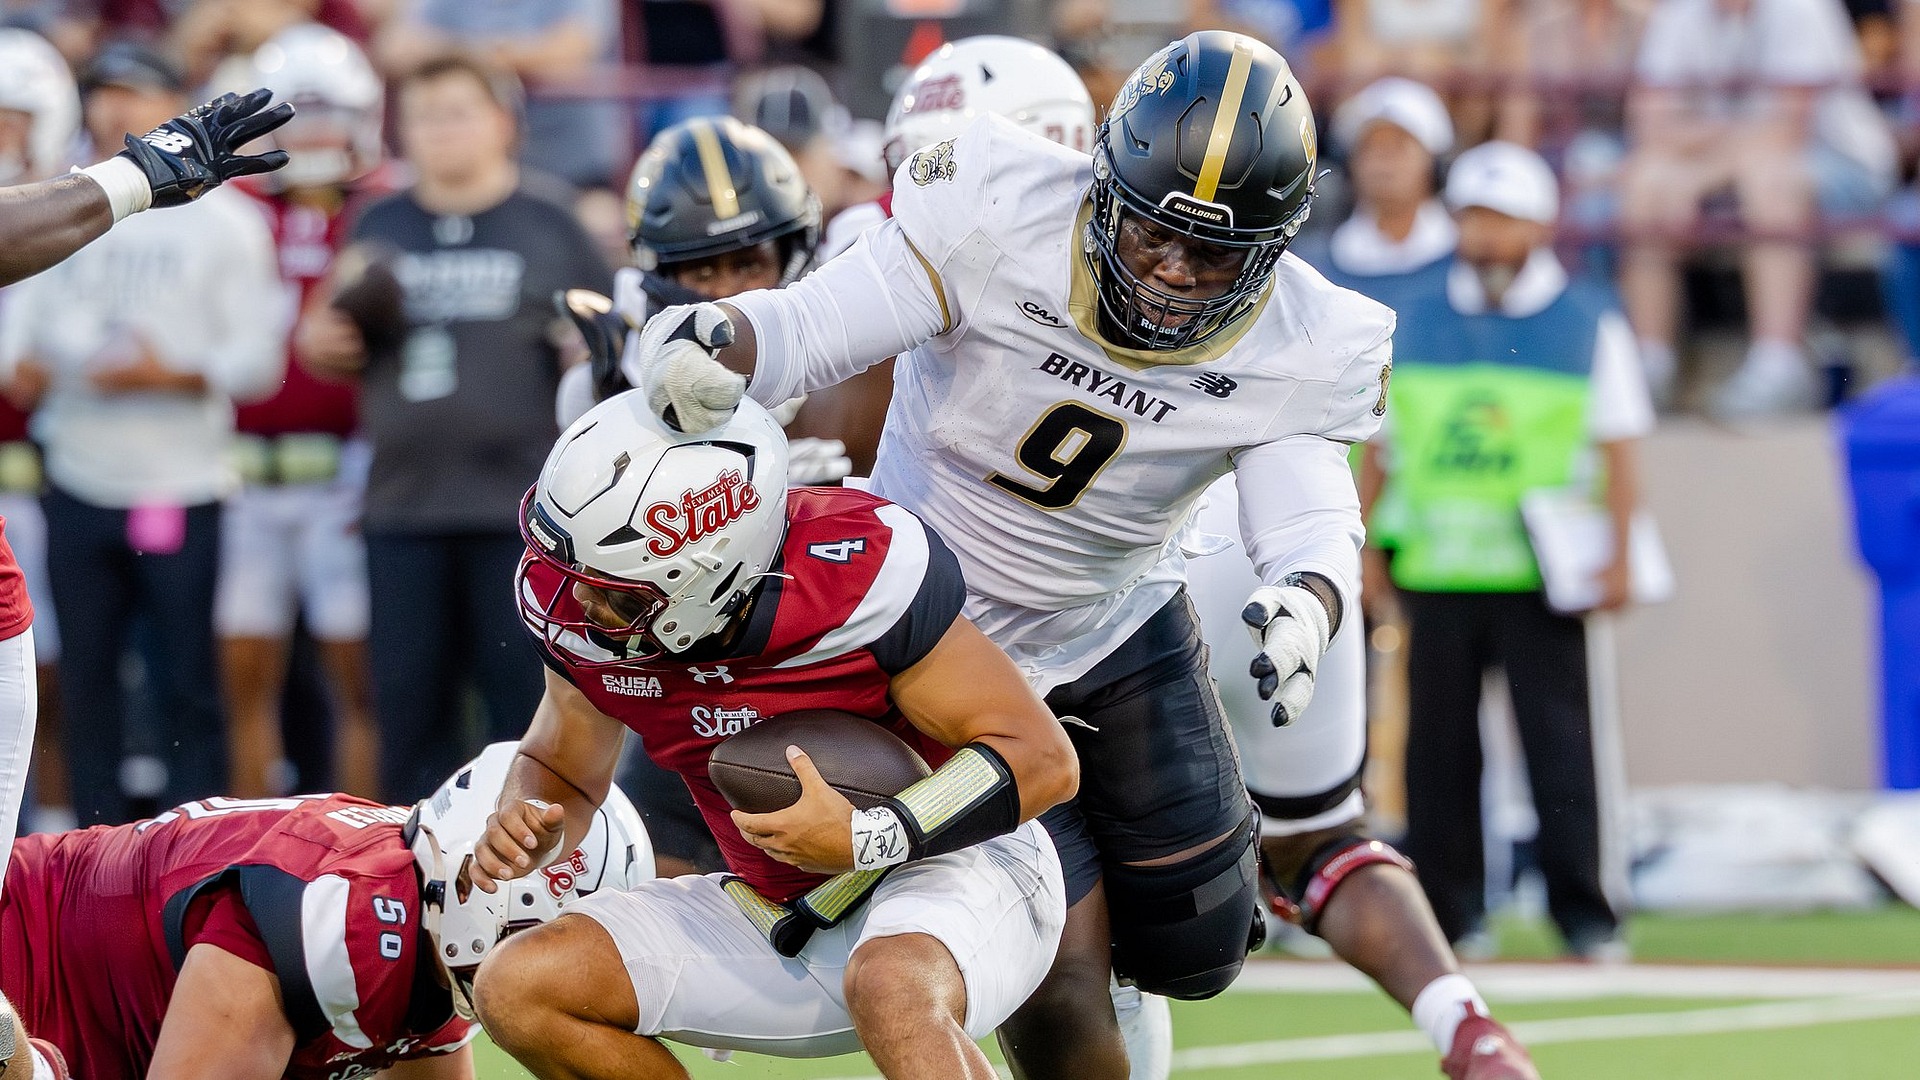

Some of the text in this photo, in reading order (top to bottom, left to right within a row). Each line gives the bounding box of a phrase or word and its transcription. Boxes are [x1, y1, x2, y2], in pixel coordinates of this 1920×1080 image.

[1174, 202, 1224, 221] BULLDOGS
[1022, 301, 1060, 325] CAA
[1038, 351, 1178, 424] BRYANT
[983, 399, 1130, 512] 9
[684, 474, 740, 512] NEW MEXICO
[644, 469, 761, 558] State
[806, 537, 867, 564] 4
[605, 685, 663, 698] GRADUATE
[691, 705, 763, 737] Stat
[371, 894, 408, 962] 50
